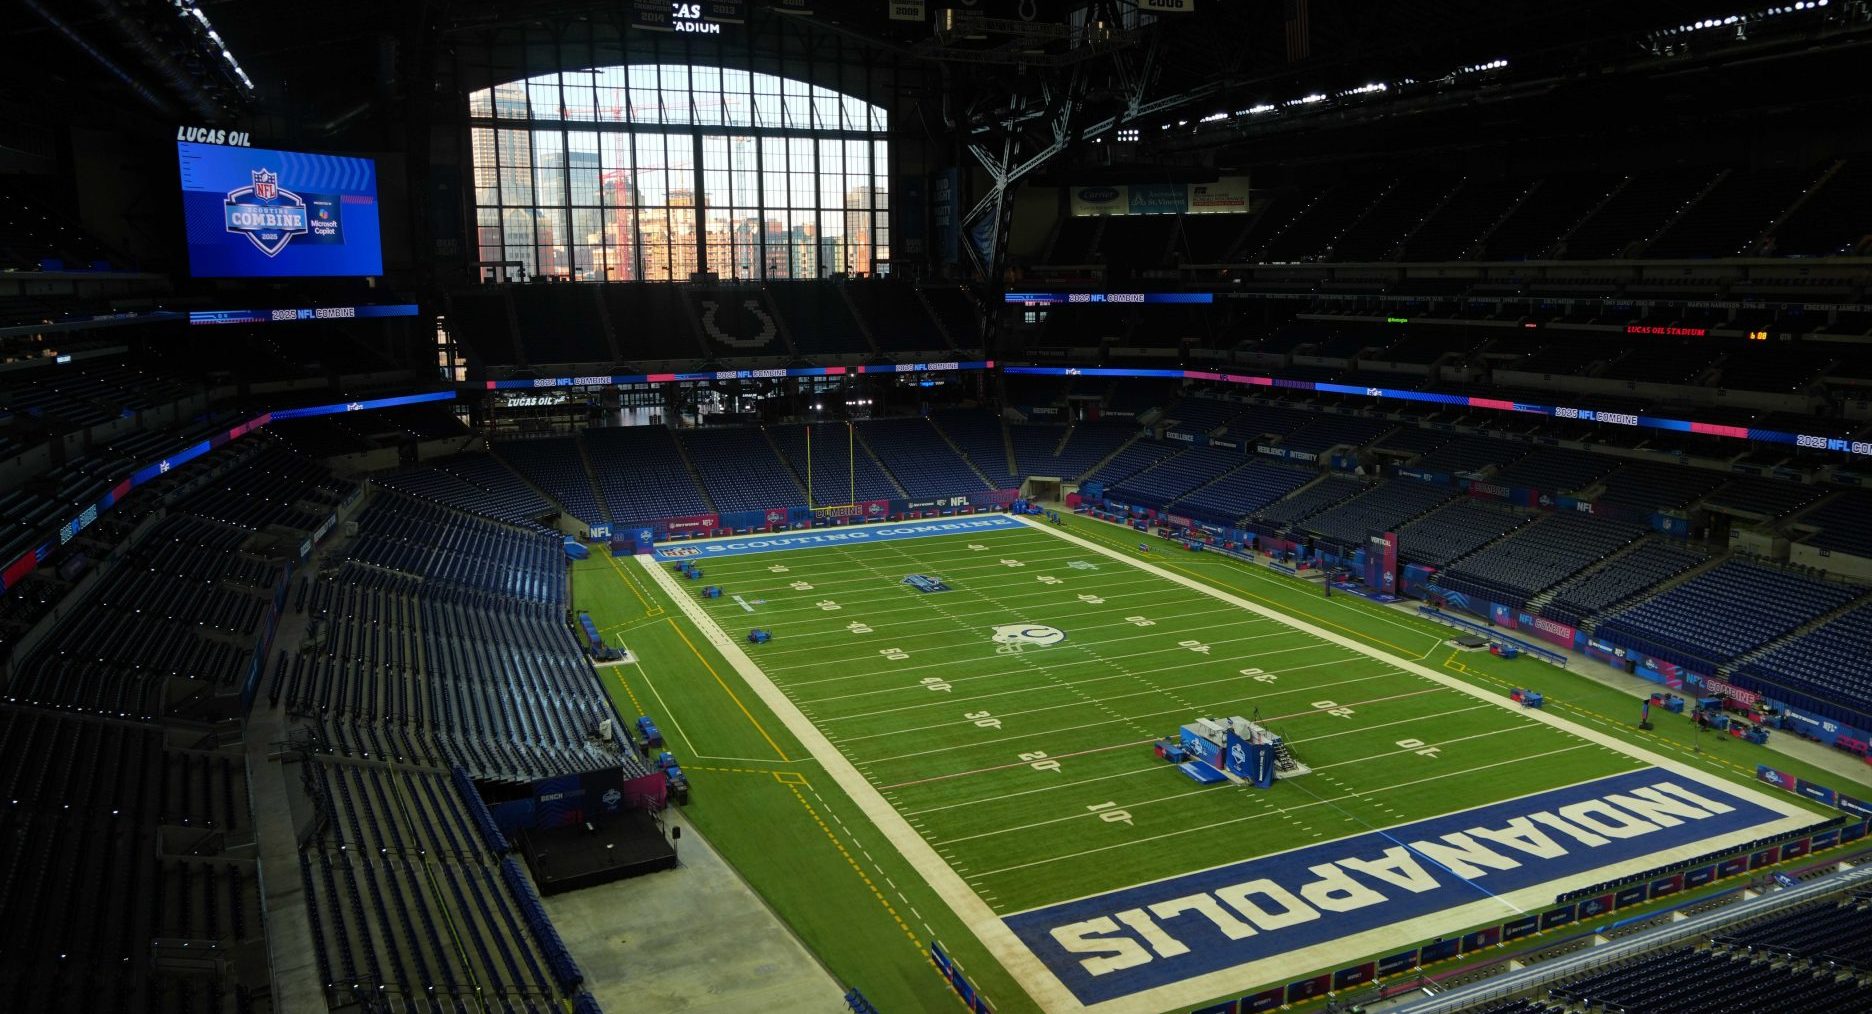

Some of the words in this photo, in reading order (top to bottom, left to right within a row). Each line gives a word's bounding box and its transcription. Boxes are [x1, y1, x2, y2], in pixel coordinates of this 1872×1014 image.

[177, 126, 226, 145] LUCAS
[228, 131, 252, 147] OIL
[255, 182, 275, 198] NFL
[231, 212, 302, 228] COMBINE
[310, 220, 338, 229] Microsoft
[314, 227, 336, 236] Copilot
[1068, 293, 1091, 303] 2025
[1090, 293, 1107, 302] NFL
[1106, 293, 1145, 303] COMBINE
[271, 310, 298, 321] 2025
[297, 309, 315, 320] NFL
[315, 307, 355, 318] COMBINE
[1626, 326, 1651, 335] LUCAS
[1651, 327, 1665, 335] OIL
[1665, 327, 1706, 337] STADIUM
[914, 363, 928, 371] NFL
[716, 371, 737, 380] 2025
[736, 370, 752, 379] NFL
[752, 369, 788, 379] COMBINE
[533, 378, 557, 388] 2025
[557, 377, 574, 387] NFL
[574, 376, 613, 386] COMBINE
[507, 397, 537, 407] LUCAS
[538, 397, 553, 406] OIL
[1555, 407, 1579, 419] 2025
[1578, 409, 1596, 422] NFL
[1595, 411, 1639, 426] COMBINE
[1796, 434, 1828, 448] 2025
[1827, 438, 1851, 453] NFL
[1289, 449, 1318, 462] INTEGRITY
[950, 496, 970, 507] NFL
[1576, 501, 1595, 514] NFL
[815, 504, 863, 519] COMBINE
[590, 527, 612, 538] NFL
[705, 532, 870, 552] SCOUTING
[876, 519, 1012, 536] COMBINE
[1518, 612, 1534, 626] NFL
[1535, 618, 1571, 639] COMBINE
[879, 647, 910, 660] 50
[919, 677, 952, 692] 40
[1686, 672, 1707, 689] NFL
[1706, 679, 1756, 705] COMBINE
[964, 710, 1001, 729] 30
[1017, 751, 1062, 773] 20
[540, 791, 564, 803] BENCH
[1086, 801, 1134, 825] 10
[1050, 781, 1737, 977] INDIANAPOLIS
